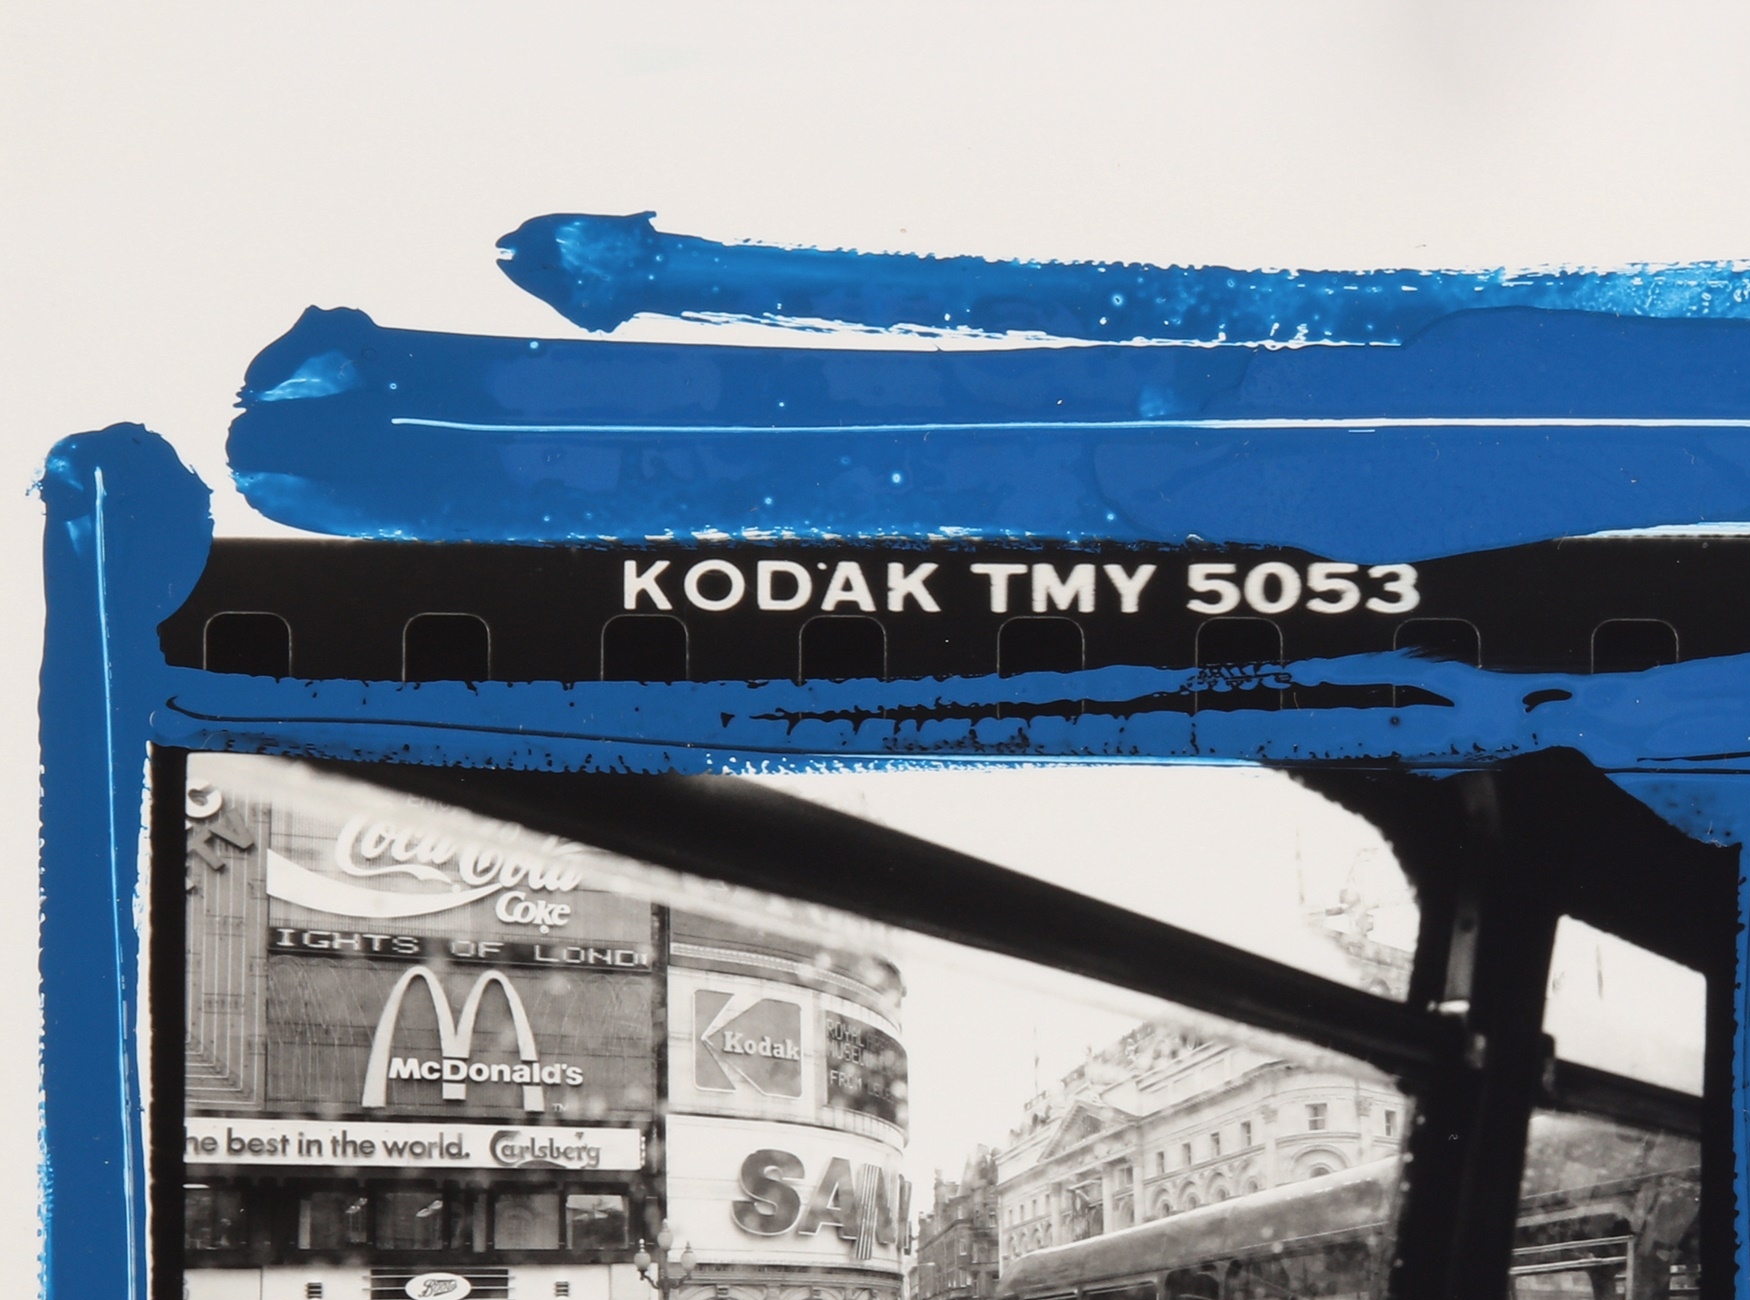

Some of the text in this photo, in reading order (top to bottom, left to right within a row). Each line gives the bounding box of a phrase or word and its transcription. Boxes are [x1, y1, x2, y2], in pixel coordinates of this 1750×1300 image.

[623, 559, 1421, 615] KODAK TMY 5053
[495, 890, 571, 926] Coke
[451, 940, 505, 958] OF
[722, 1029, 801, 1061] Kodak
[388, 1057, 584, 1086] McDonald's
[227, 1127, 289, 1156] best
[298, 1131, 323, 1157] in
[331, 1130, 375, 1158] the
[382, 1132, 471, 1160] world.
[489, 1129, 602, 1169] Carlsberg
